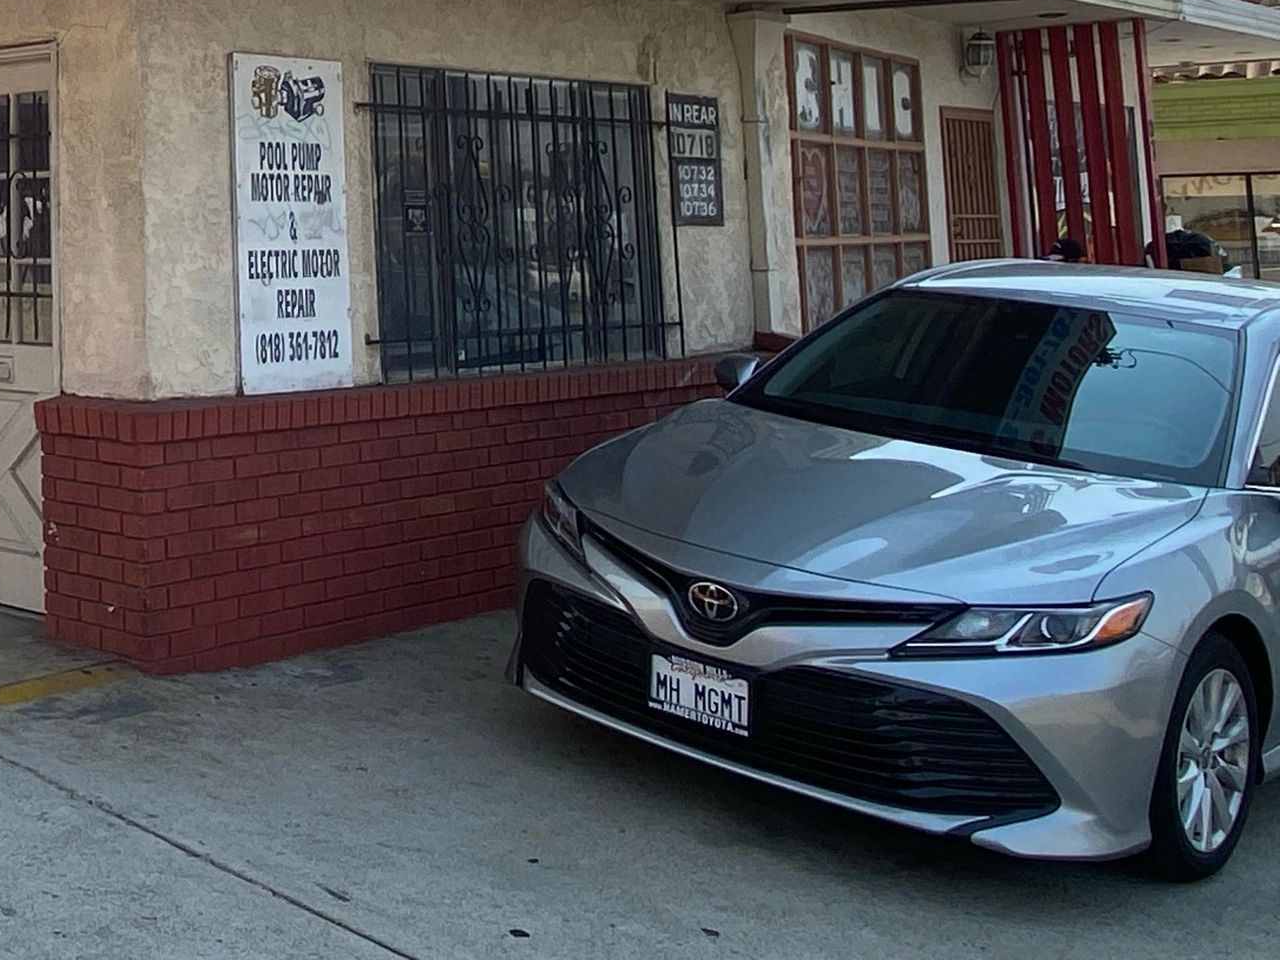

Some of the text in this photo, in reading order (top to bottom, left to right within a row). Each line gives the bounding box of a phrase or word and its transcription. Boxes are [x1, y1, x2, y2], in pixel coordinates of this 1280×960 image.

[668, 103, 717, 125] IN REAR
[259, 141, 321, 172] POOL PUMP
[251, 173, 332, 203] MOTOR REPAIR
[678, 165, 715, 180] 10732
[680, 183, 716, 198] 10734
[680, 201, 717, 217] 10736
[288, 210, 298, 242] &
[248, 248, 340, 280] ELECTRIC MOTOR
[276, 288, 316, 319] REPAIR
[256, 329, 339, 366] (818) 361-7812
[656, 671, 747, 723] MH MGMT
